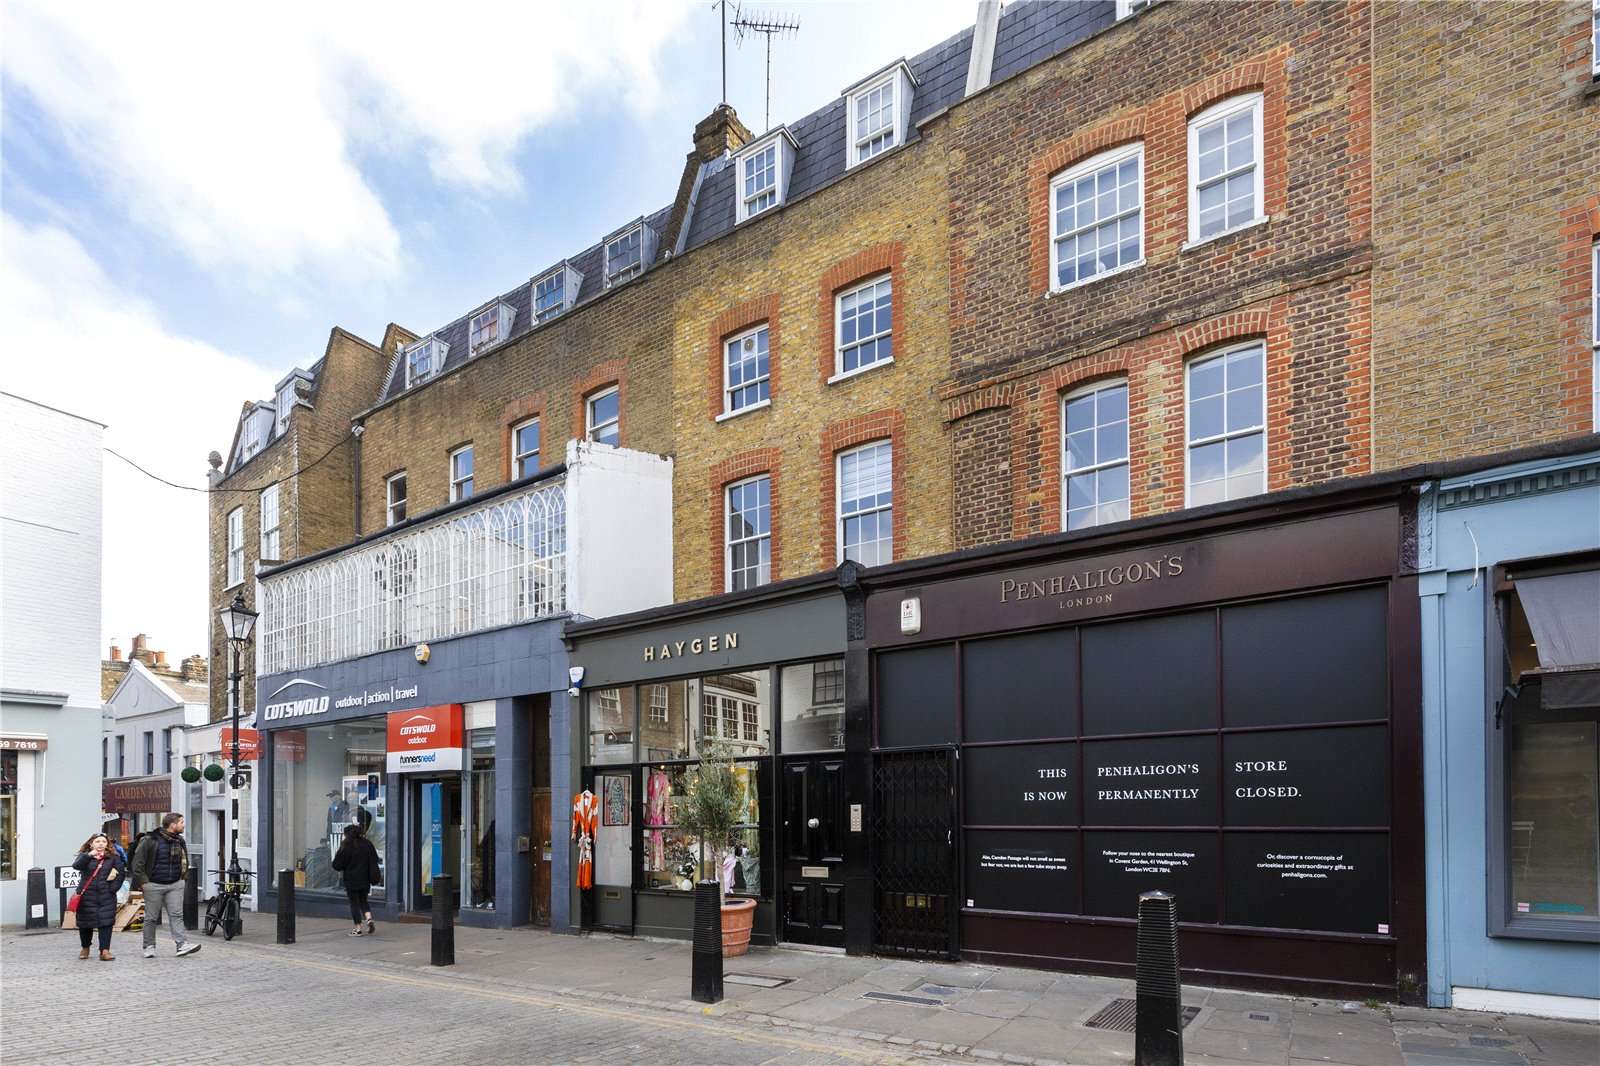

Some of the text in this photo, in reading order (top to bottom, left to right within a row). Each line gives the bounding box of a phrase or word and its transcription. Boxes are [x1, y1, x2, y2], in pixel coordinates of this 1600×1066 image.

[1000, 555, 1184, 603] PENHALIGON'S
[1059, 593, 1113, 609] LONDON
[644, 632, 738, 661] HAYGEN
[335, 685, 418, 709] outdoor action travel
[264, 696, 330, 721] COTSWOLD
[400, 724, 436, 735] COTSWOLD
[408, 736, 428, 744] outdoor
[1038, 760, 1288, 778] THIS PENHALIGON'S STORE
[1024, 786, 1302, 801] IS NOW PERMANENTLY CLOSED.
